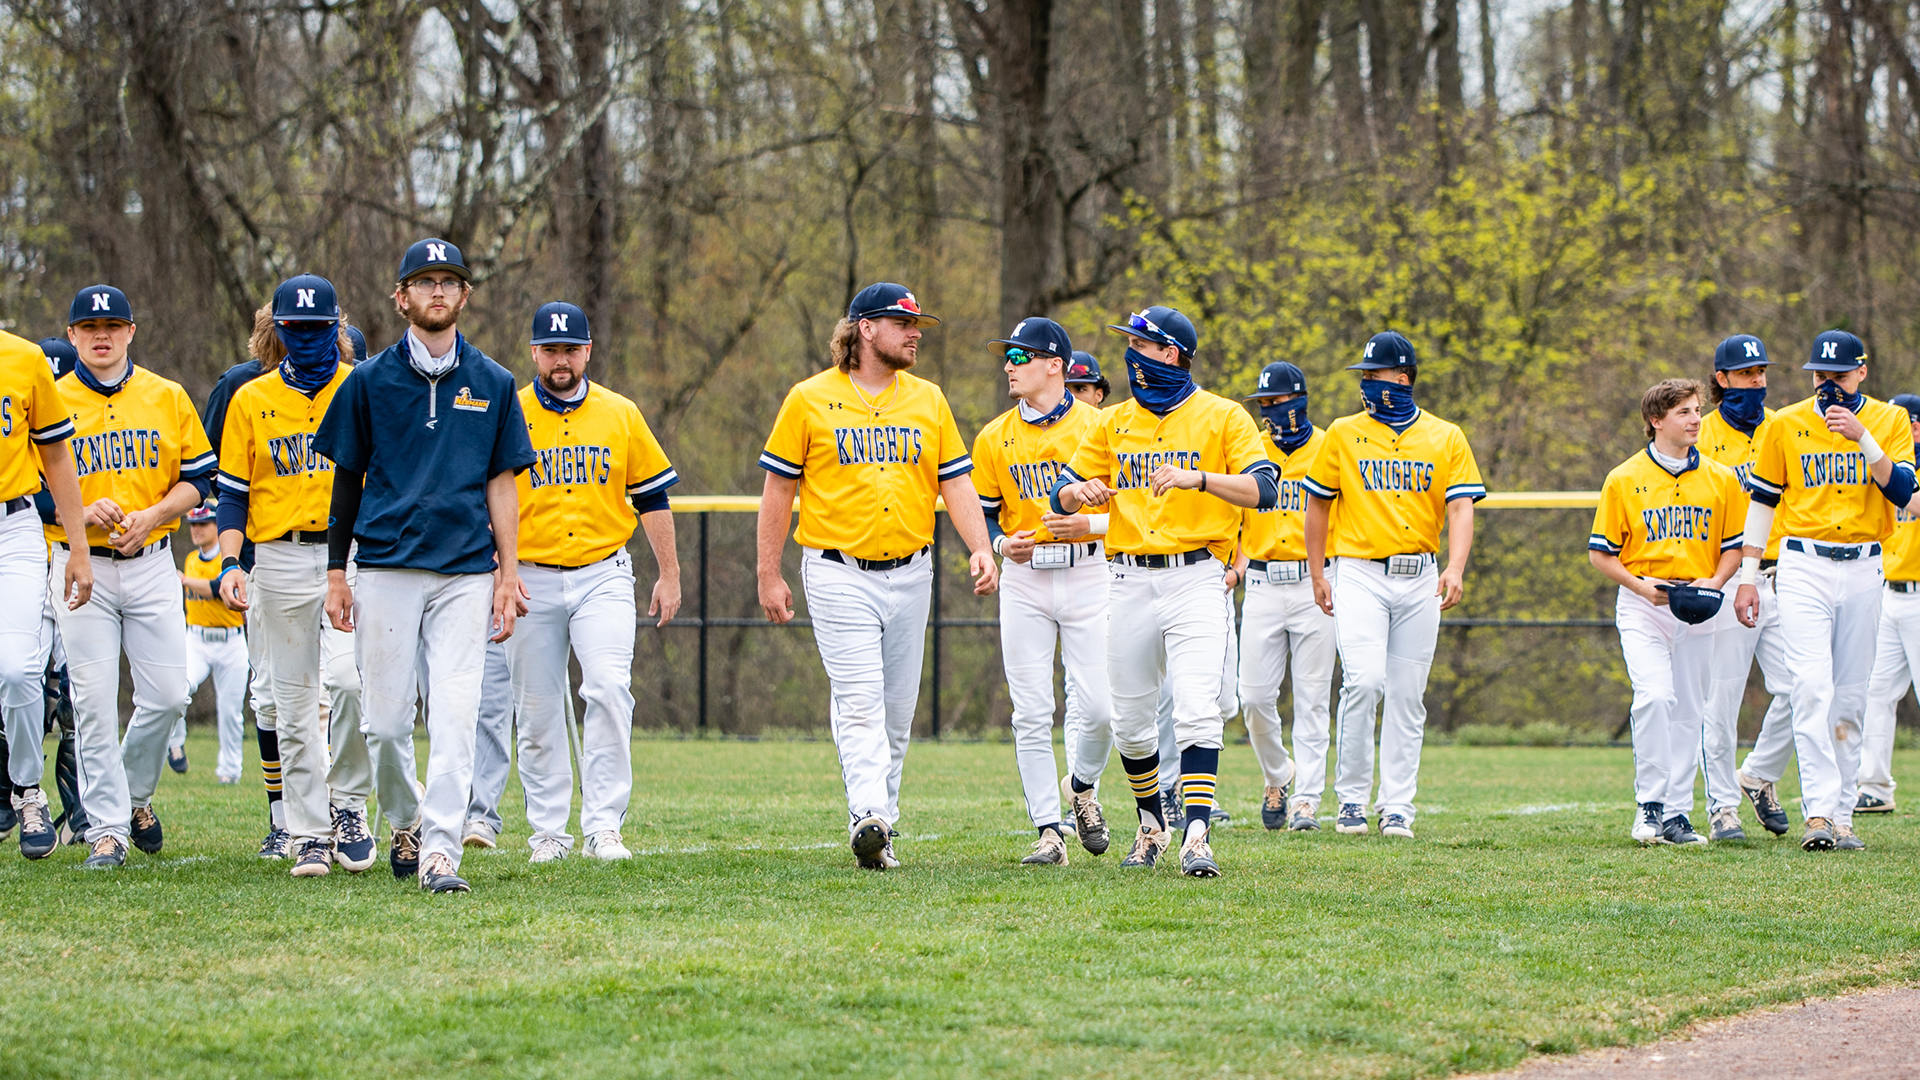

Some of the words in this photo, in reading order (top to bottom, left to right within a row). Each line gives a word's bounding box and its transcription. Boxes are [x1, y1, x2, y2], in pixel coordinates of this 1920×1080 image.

[427, 243, 447, 262] N
[92, 293, 110, 311] N
[297, 288, 315, 308] N
[551, 313, 568, 332] N
[1363, 342, 1376, 358] N
[1743, 341, 1760, 357] N
[1821, 341, 1837, 359] N
[1258, 372, 1271, 388] N
[71, 429, 160, 478] KNIGHTS
[267, 432, 337, 477] KNIG
[834, 425, 922, 466] KNIGHTS
[1358, 459, 1434, 492] KNIGHTS
[1800, 452, 1874, 488] KNIGHT
[1642, 505, 1712, 543] KNIGHTS
